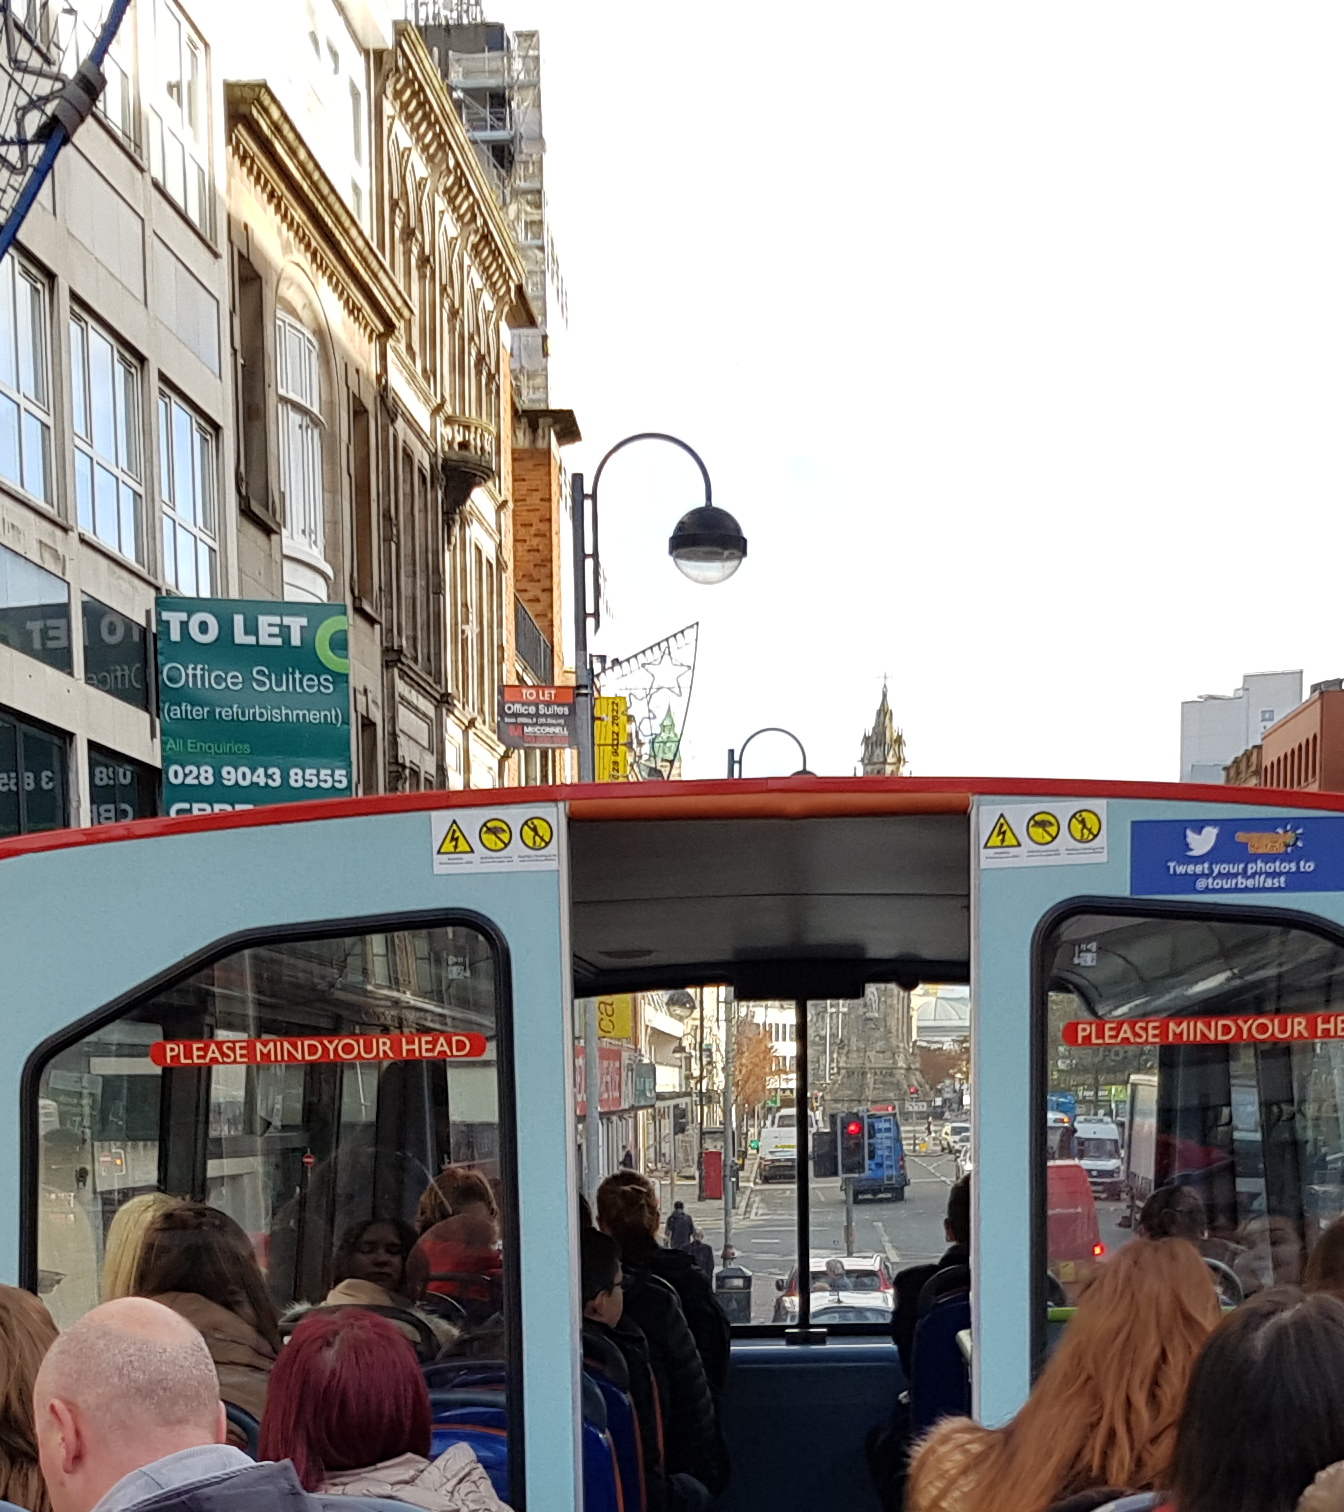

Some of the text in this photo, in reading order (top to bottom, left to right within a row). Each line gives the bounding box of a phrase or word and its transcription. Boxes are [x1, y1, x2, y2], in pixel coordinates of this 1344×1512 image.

[161, 611, 308, 646] TO LET
[163, 662, 335, 694] Office Suites
[521, 689, 557, 701] TO LET
[164, 702, 342, 727] (after refurbishment)
[504, 703, 569, 715] Office Suites
[165, 738, 251, 757] All Enquiries
[168, 764, 348, 789] 028 9043 8555
[1167, 859, 1315, 877] Tweet your photos to
[1195, 874, 1286, 891] @tourbelfast
[1077, 1020, 1160, 1044] PLEASE
[1168, 1018, 1236, 1042] MIND
[1235, 1015, 1309, 1040] YOUR
[166, 1035, 471, 1064] PLEASE MIND YOUR HEAD
